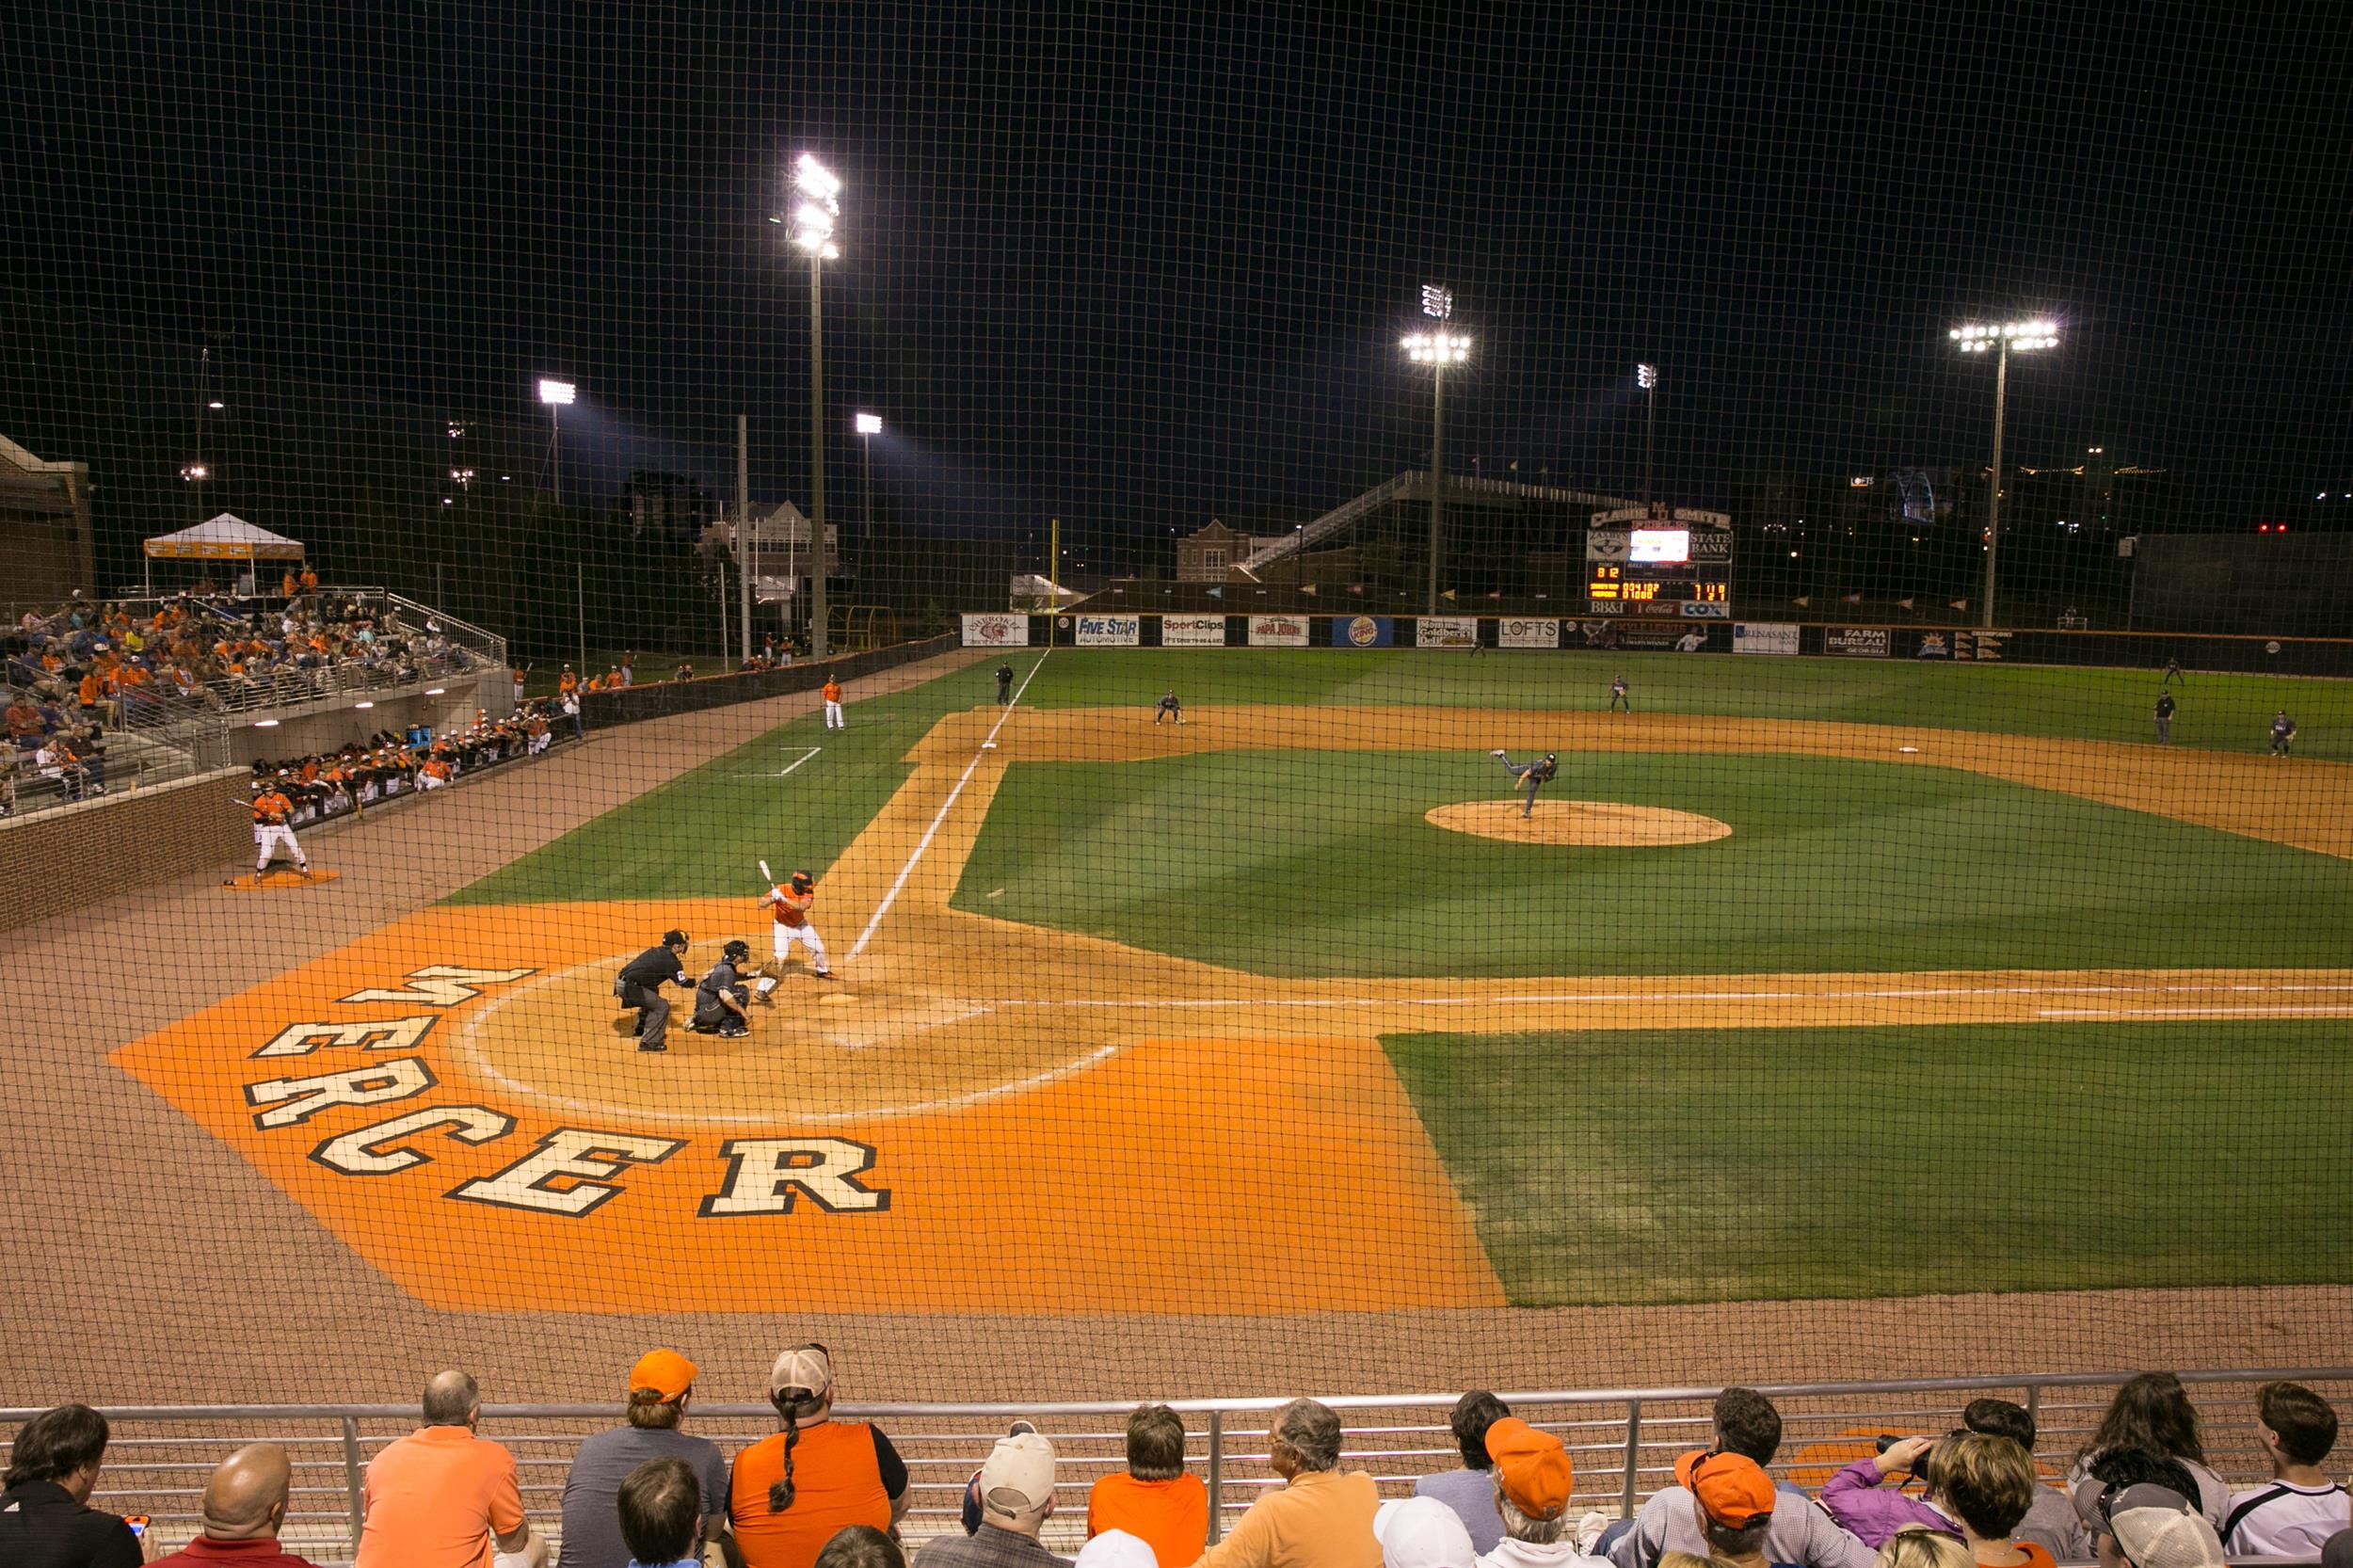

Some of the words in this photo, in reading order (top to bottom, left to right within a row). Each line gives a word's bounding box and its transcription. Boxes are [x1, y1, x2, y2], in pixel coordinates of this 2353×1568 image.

[1850, 477, 1874, 487] LOFTS
[1690, 533, 1731, 544] STATE
[1692, 544, 1728, 553] BANK
[1591, 601, 1627, 613] BB&T
[1685, 604, 1721, 615] COX
[1079, 618, 1104, 634] FIVE
[1107, 618, 1137, 634] STAR
[1257, 624, 1275, 634] PAPA
[1502, 621, 1556, 636] LOFTS
[1353, 628, 1373, 639] KING
[1845, 629, 1885, 638] FARM
[1828, 637, 1887, 646] BUREAU
[243, 964, 892, 1219] MERCER
